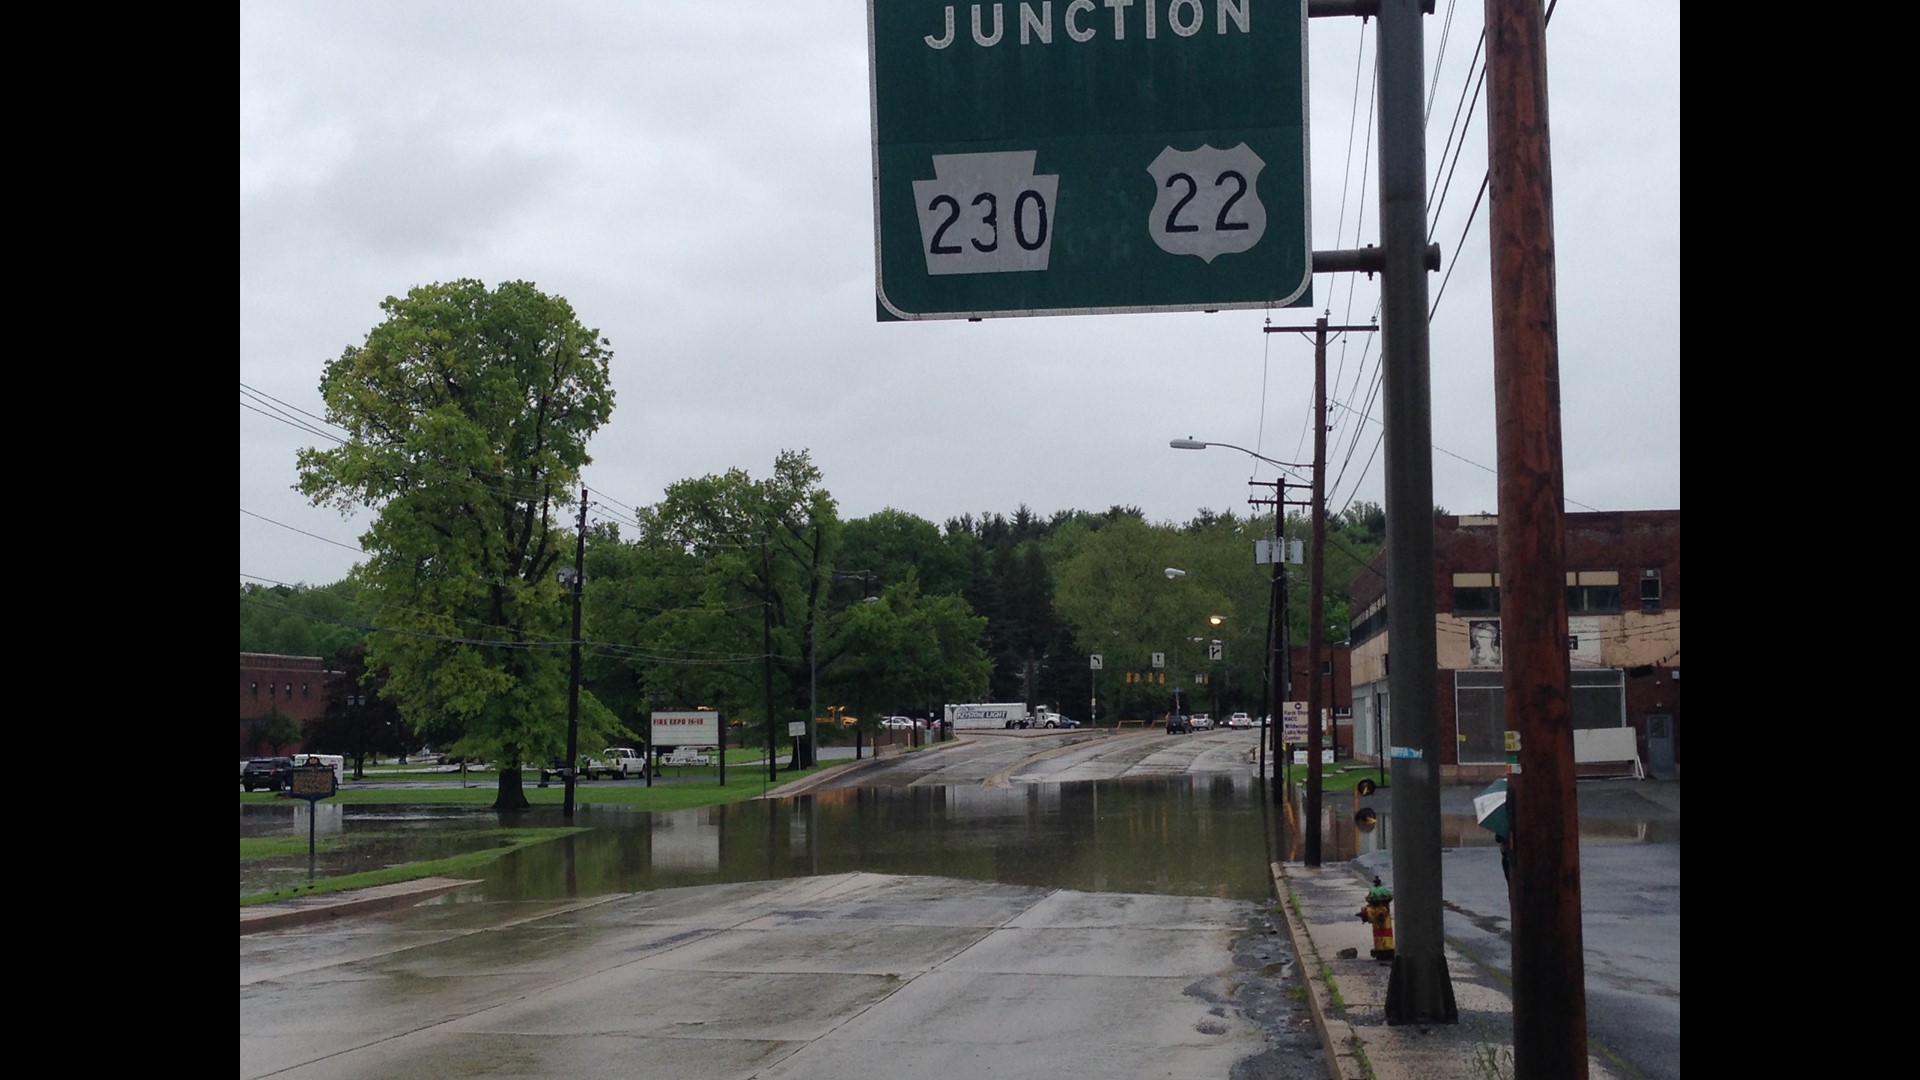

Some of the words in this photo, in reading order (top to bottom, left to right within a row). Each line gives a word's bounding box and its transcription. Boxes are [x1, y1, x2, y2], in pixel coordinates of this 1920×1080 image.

[924, 0, 1250, 49] JUNCTION
[928, 190, 1048, 255] 230
[1165, 170, 1250, 233] 22
